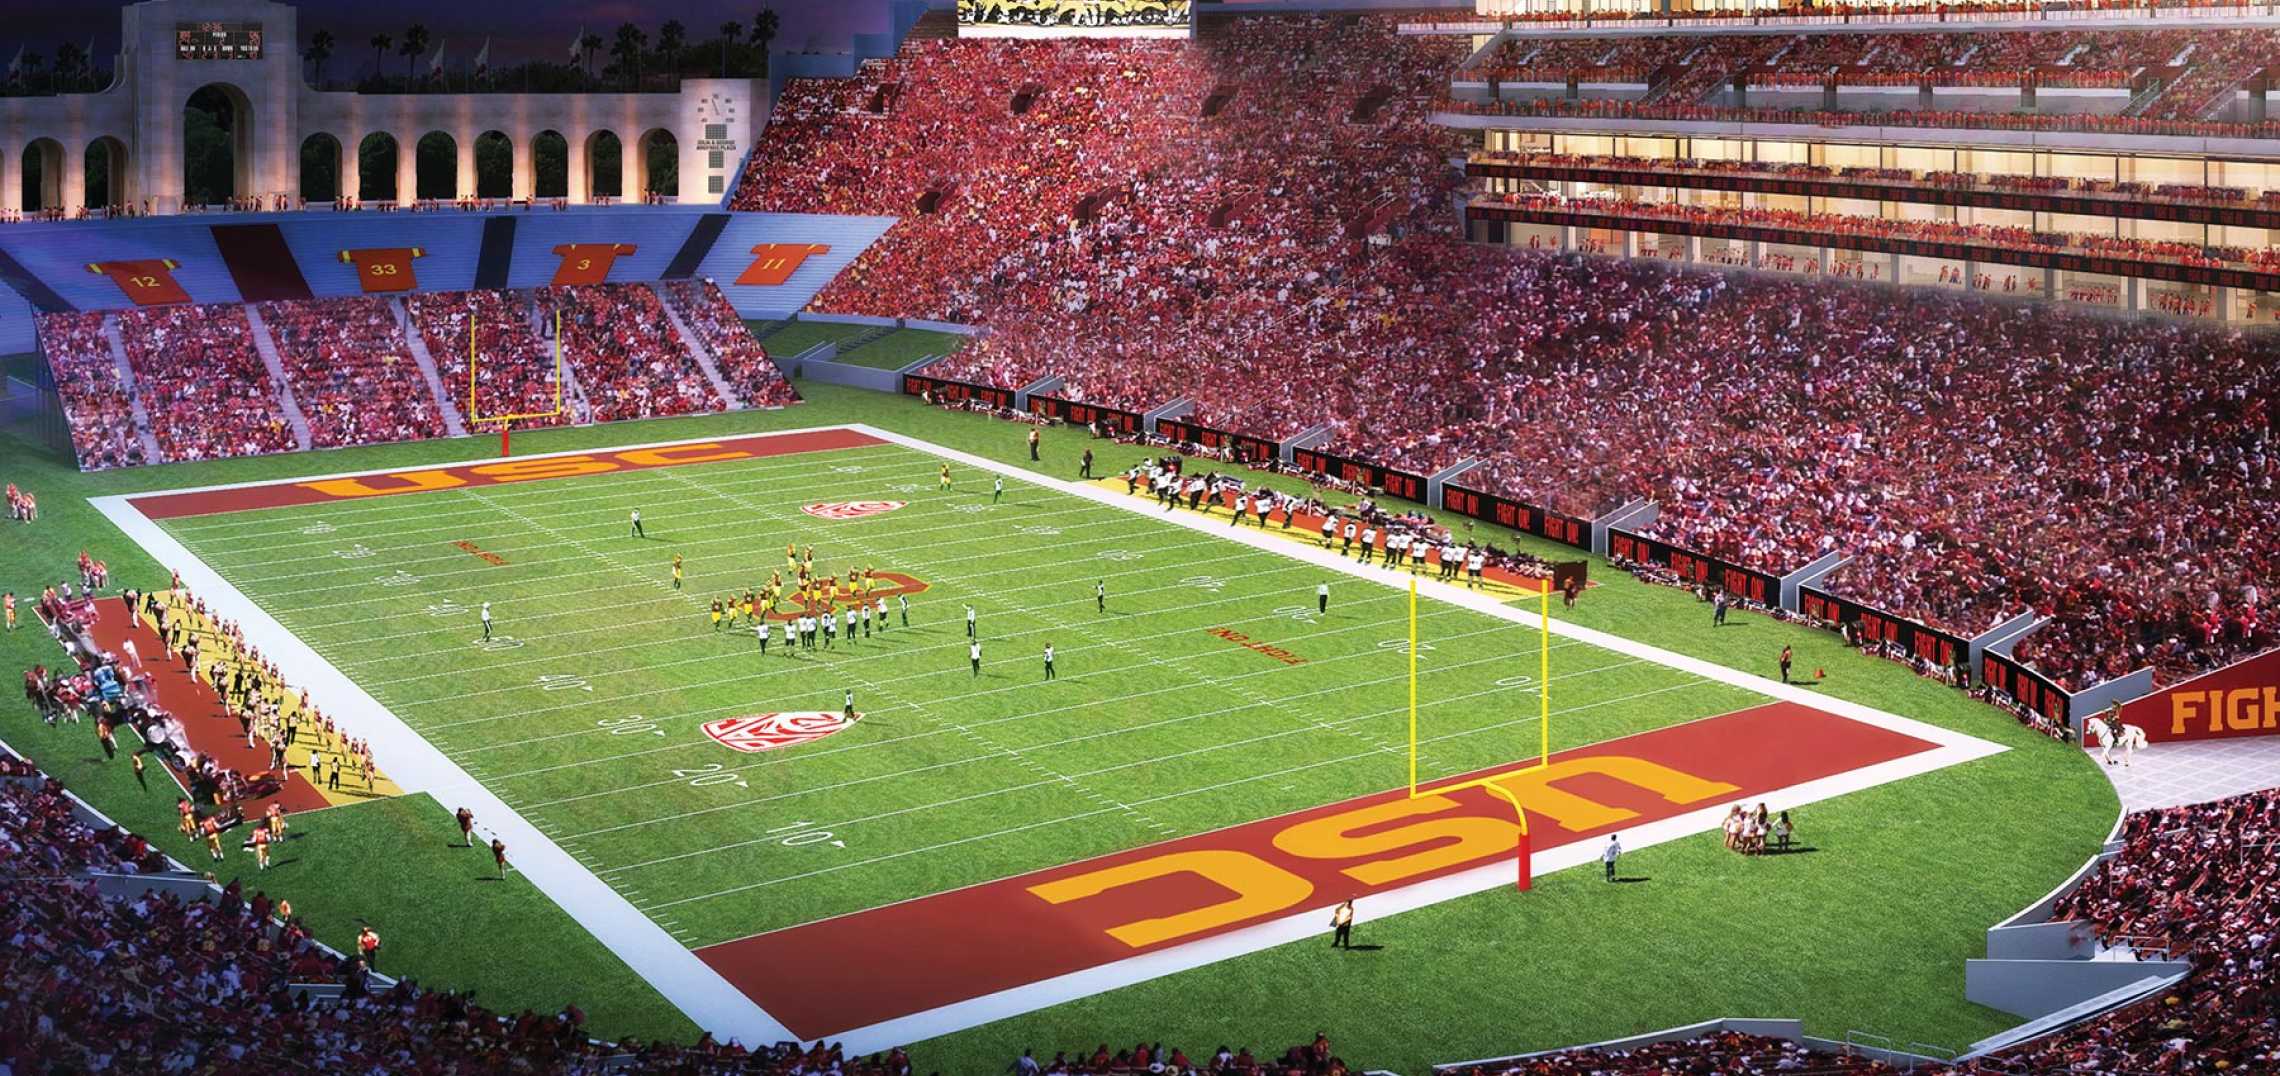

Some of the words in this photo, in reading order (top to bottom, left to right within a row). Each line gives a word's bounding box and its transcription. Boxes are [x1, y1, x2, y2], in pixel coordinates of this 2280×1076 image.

[370, 263, 398, 276] 33
[577, 259, 591, 270] 3
[761, 257, 787, 270] 11
[130, 276, 161, 288] 12
[298, 442, 754, 498] USC
[1724, 567, 1747, 598] FIGHT
[1750, 574, 1765, 603] ON!
[598, 714, 657, 736] 30
[672, 763, 739, 787] 20
[765, 820, 834, 846] 10
[1024, 756, 1744, 948] USC
